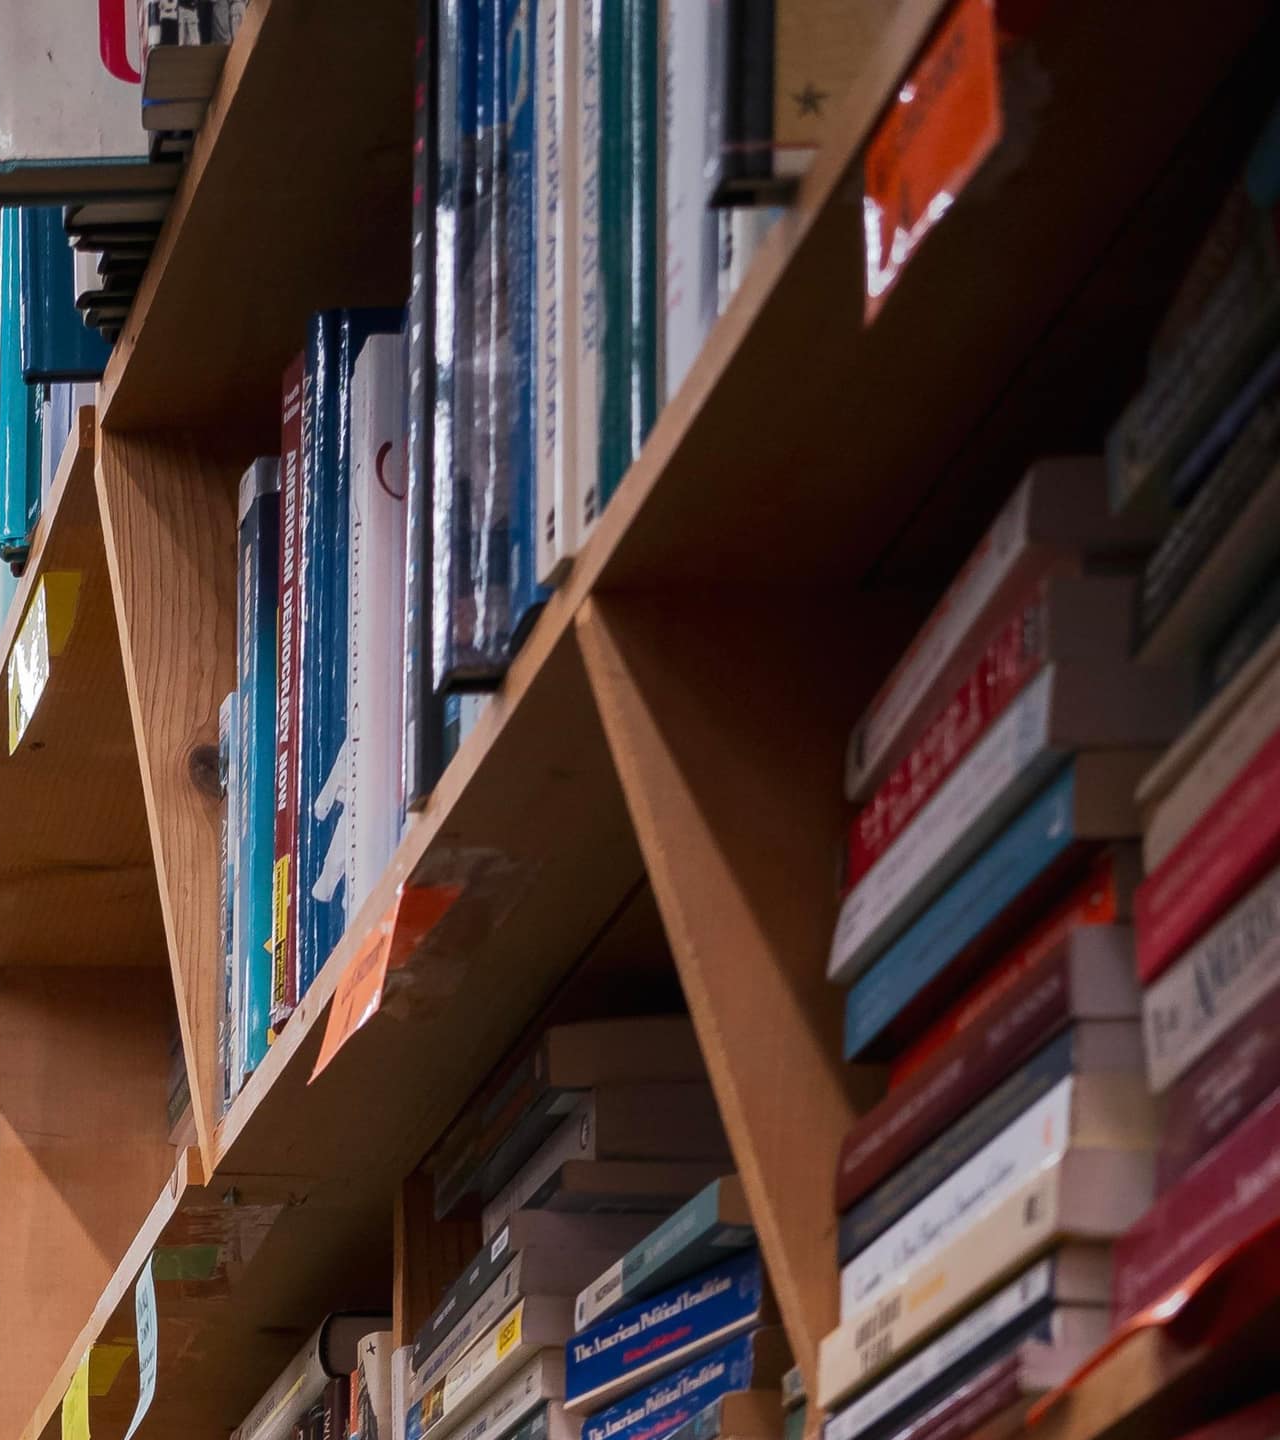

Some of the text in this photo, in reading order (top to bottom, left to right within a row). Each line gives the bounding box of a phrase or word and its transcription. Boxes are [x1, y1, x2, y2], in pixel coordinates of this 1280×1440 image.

[278, 450, 297, 811] AMERICAN DEMOCRACY NOW
[574, 1277, 734, 1363] The American Political Tradition
